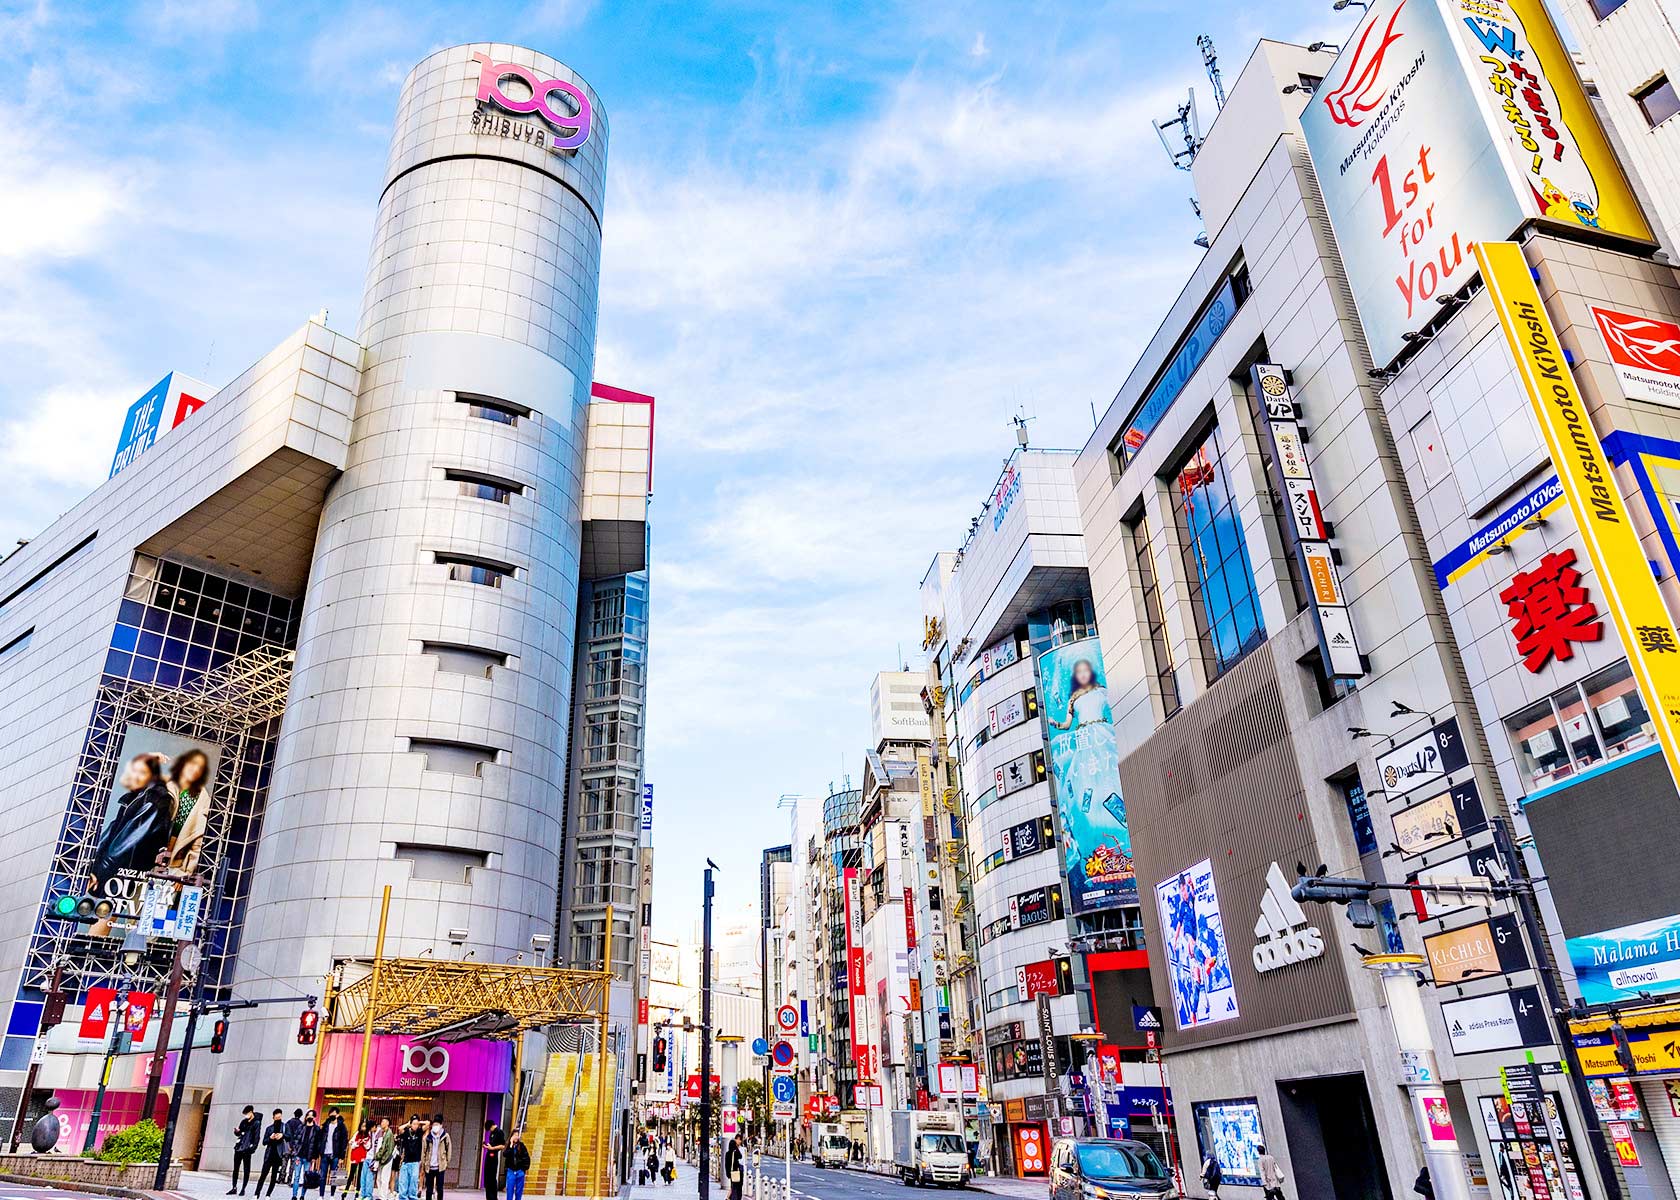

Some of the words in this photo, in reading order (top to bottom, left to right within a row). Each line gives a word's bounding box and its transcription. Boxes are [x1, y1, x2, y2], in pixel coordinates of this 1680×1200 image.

[473, 52, 592, 149] 109
[1340, 105, 1389, 176] Matsumoto
[1389, 51, 1425, 106] KiYoshi
[471, 110, 545, 146] SHIBUYA
[1363, 101, 1406, 160] Holdings
[1371, 144, 1436, 239] 1st
[1399, 201, 1435, 258] for
[1513, 301, 1563, 382] KiYoshi
[1176, 337, 1200, 381] UP
[1623, 372, 1672, 389] Matsumoto
[1266, 395, 1290, 403] Darts
[1267, 403, 1292, 417] UP
[129, 395, 158, 442] THE
[1552, 385, 1620, 523] Matsumoto
[1294, 492, 1313, 536] スシロー
[1468, 504, 1530, 555] Matsumoto
[1529, 480, 1564, 512] KiYos
[1499, 548, 1605, 674] 薬
[1636, 625, 1678, 655] 薬
[891, 715, 929, 727] SoftBank
[117, 868, 138, 878] 2022
[1021, 909, 1048, 925] BAGUS
[1253, 926, 1326, 974] adidas
[1615, 967, 1659, 987] allhawaii
[782, 1011, 795, 1024] 30
[1138, 1020, 1161, 1029] adidas
[400, 1045, 449, 1087] 109
[1418, 1068, 1431, 1081] 2
[1585, 1060, 1619, 1069] Matsumo
[1633, 1053, 1657, 1066] iYoshi
[400, 1077, 430, 1087] SHIBUYA
[777, 1082, 787, 1099] P
[1131, 1098, 1159, 1107] サーティワン
